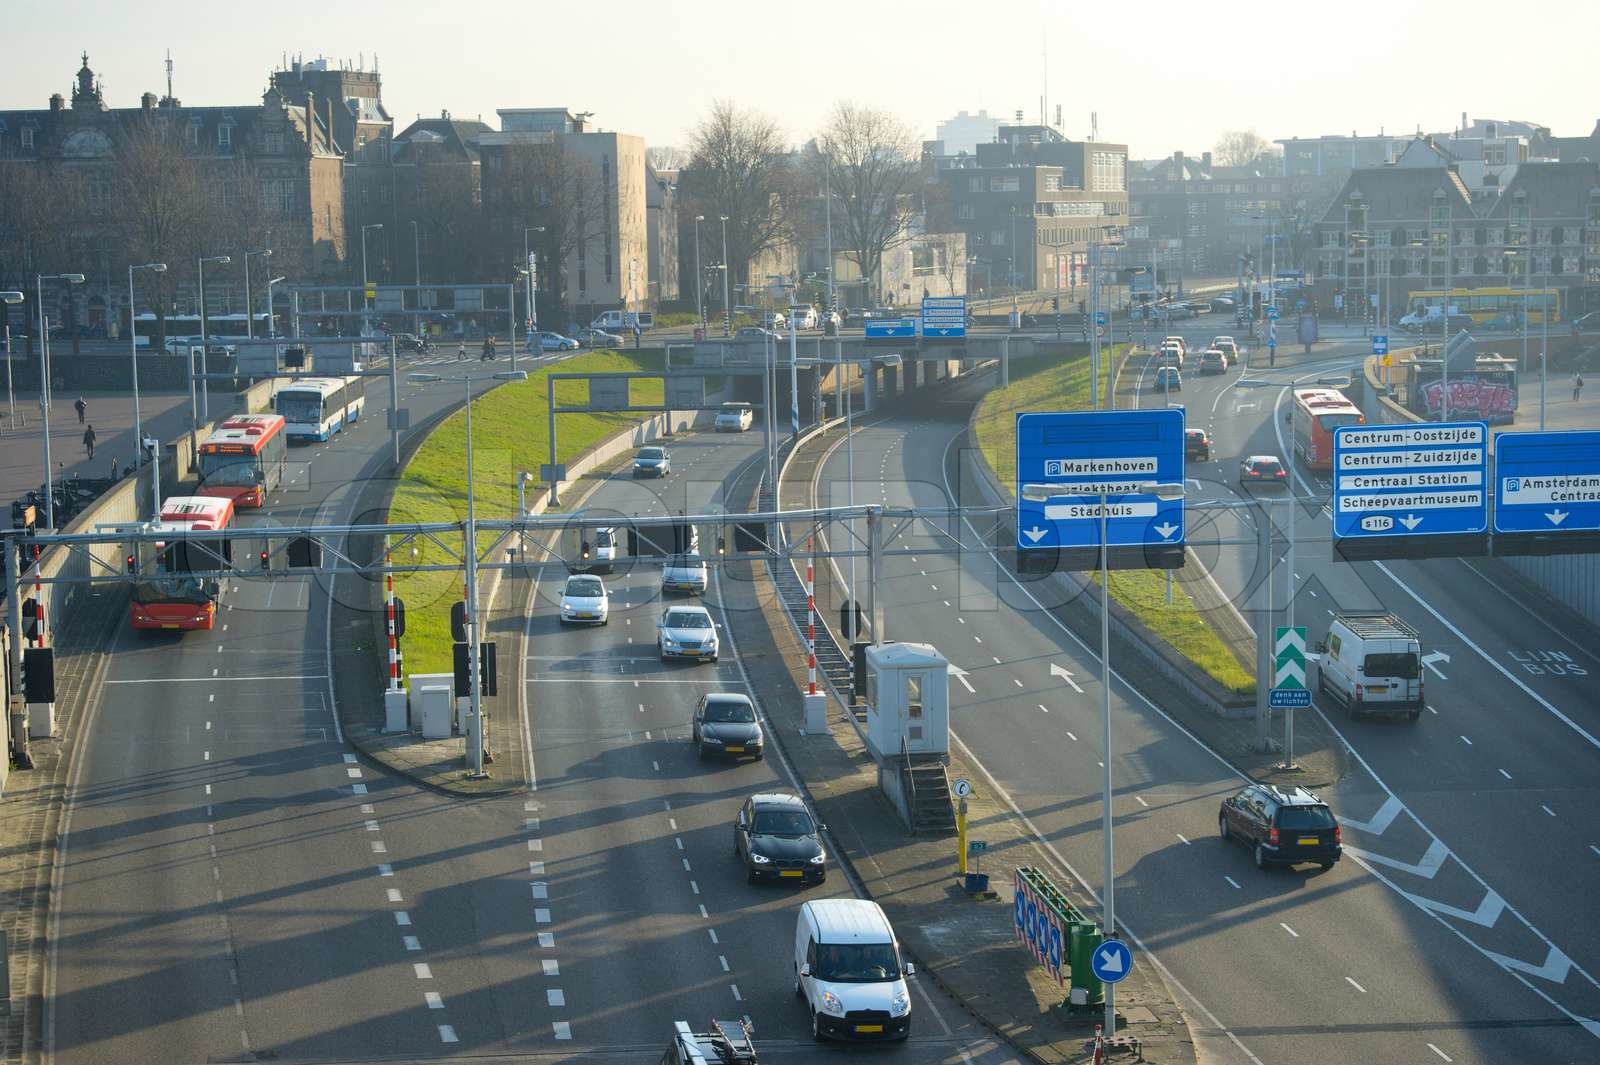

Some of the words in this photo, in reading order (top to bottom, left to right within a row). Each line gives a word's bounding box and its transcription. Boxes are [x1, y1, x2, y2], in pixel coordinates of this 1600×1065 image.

[1344, 429, 1477, 444] Centrum-Oostzijde
[1344, 451, 1477, 466] Centrum-Zuidzijde
[1064, 461, 1154, 473] Markenhoven
[1354, 475, 1412, 487] Centraal
[1418, 474, 1468, 485] Station
[1522, 478, 1599, 489] Amsterdam
[1343, 495, 1479, 508] Scheepvaartmuseum
[1521, 663, 1588, 675] BUS
